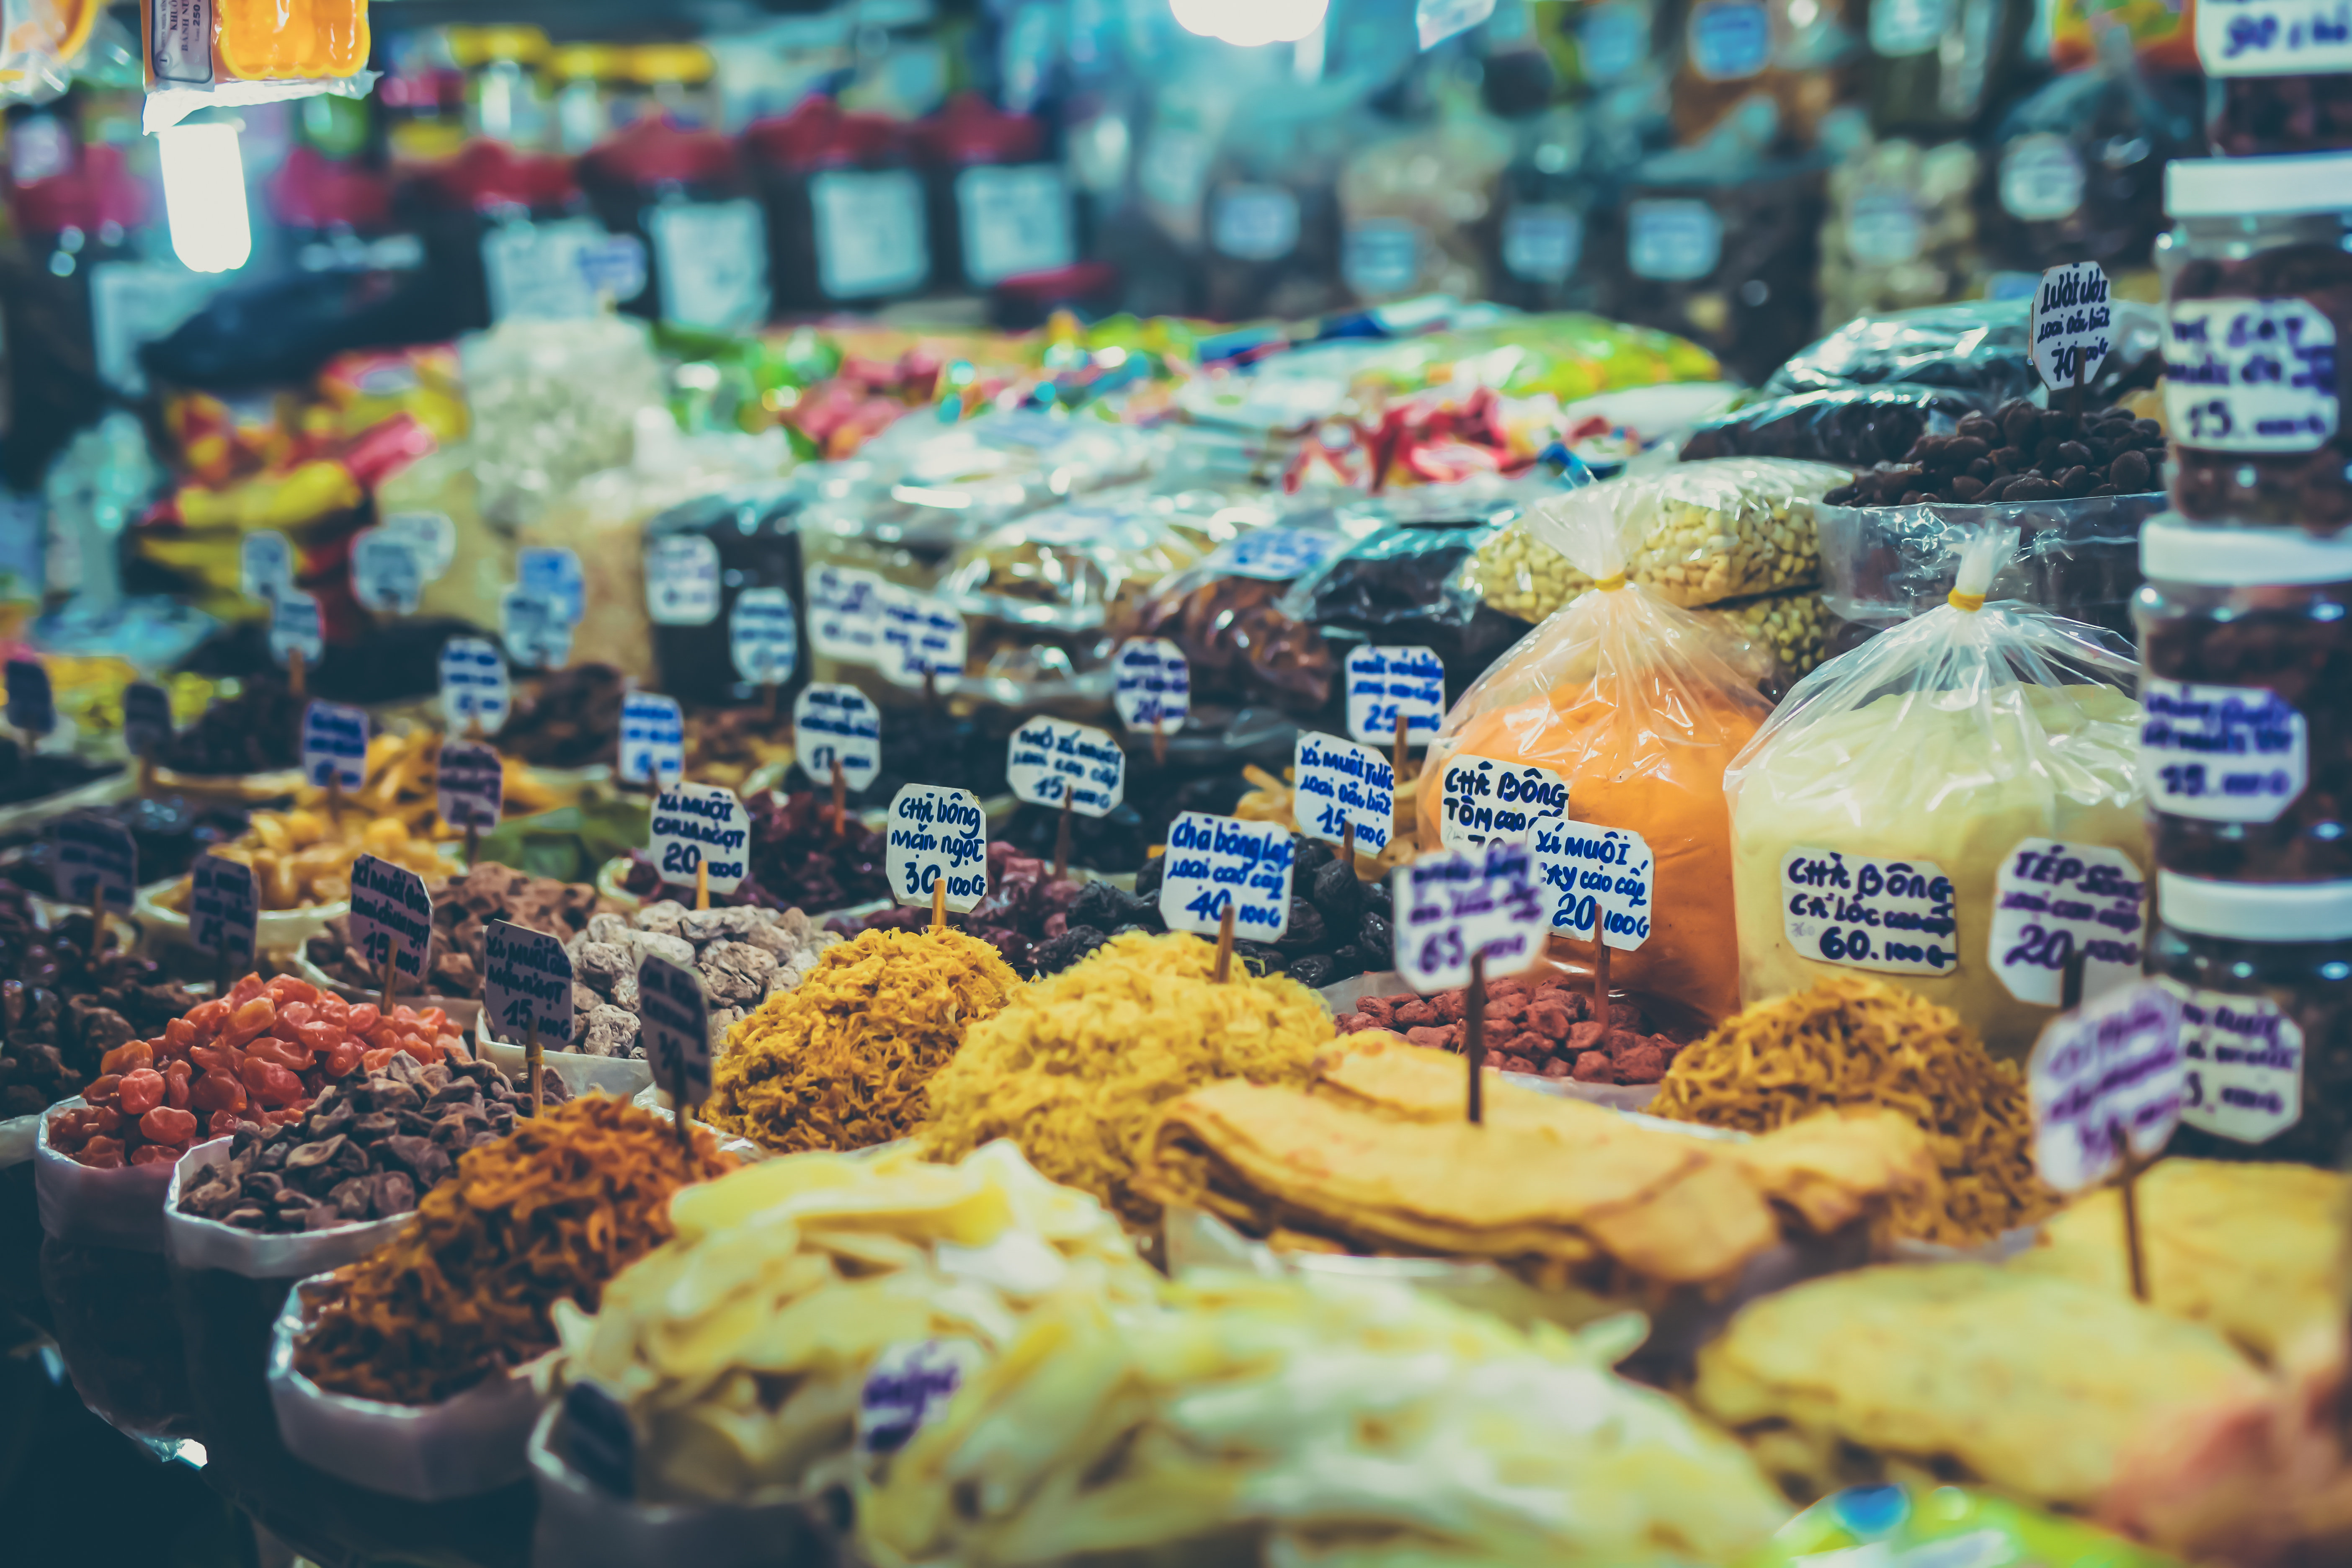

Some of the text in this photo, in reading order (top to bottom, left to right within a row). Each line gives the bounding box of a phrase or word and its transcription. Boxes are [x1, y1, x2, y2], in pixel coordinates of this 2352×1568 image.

[2051, 345, 2077, 382] 70
[1364, 704, 1400, 733] 25
[1033, 775, 1066, 799] 15
[1496, 767, 1570, 809] BÔNG
[1316, 805, 1346, 836] 15
[1443, 795, 1493, 832] TÔM
[663, 842, 701, 874] 20
[905, 862, 986, 896] 30 100G
[1579, 870, 1612, 892] cao
[1857, 862, 1955, 903] BÔNG
[1185, 888, 1232, 922] 40
[1552, 892, 1650, 939] 20 100G
[363, 931, 390, 964] 15
[2003, 923, 2074, 970] 20
[502, 998, 534, 1030] 15
